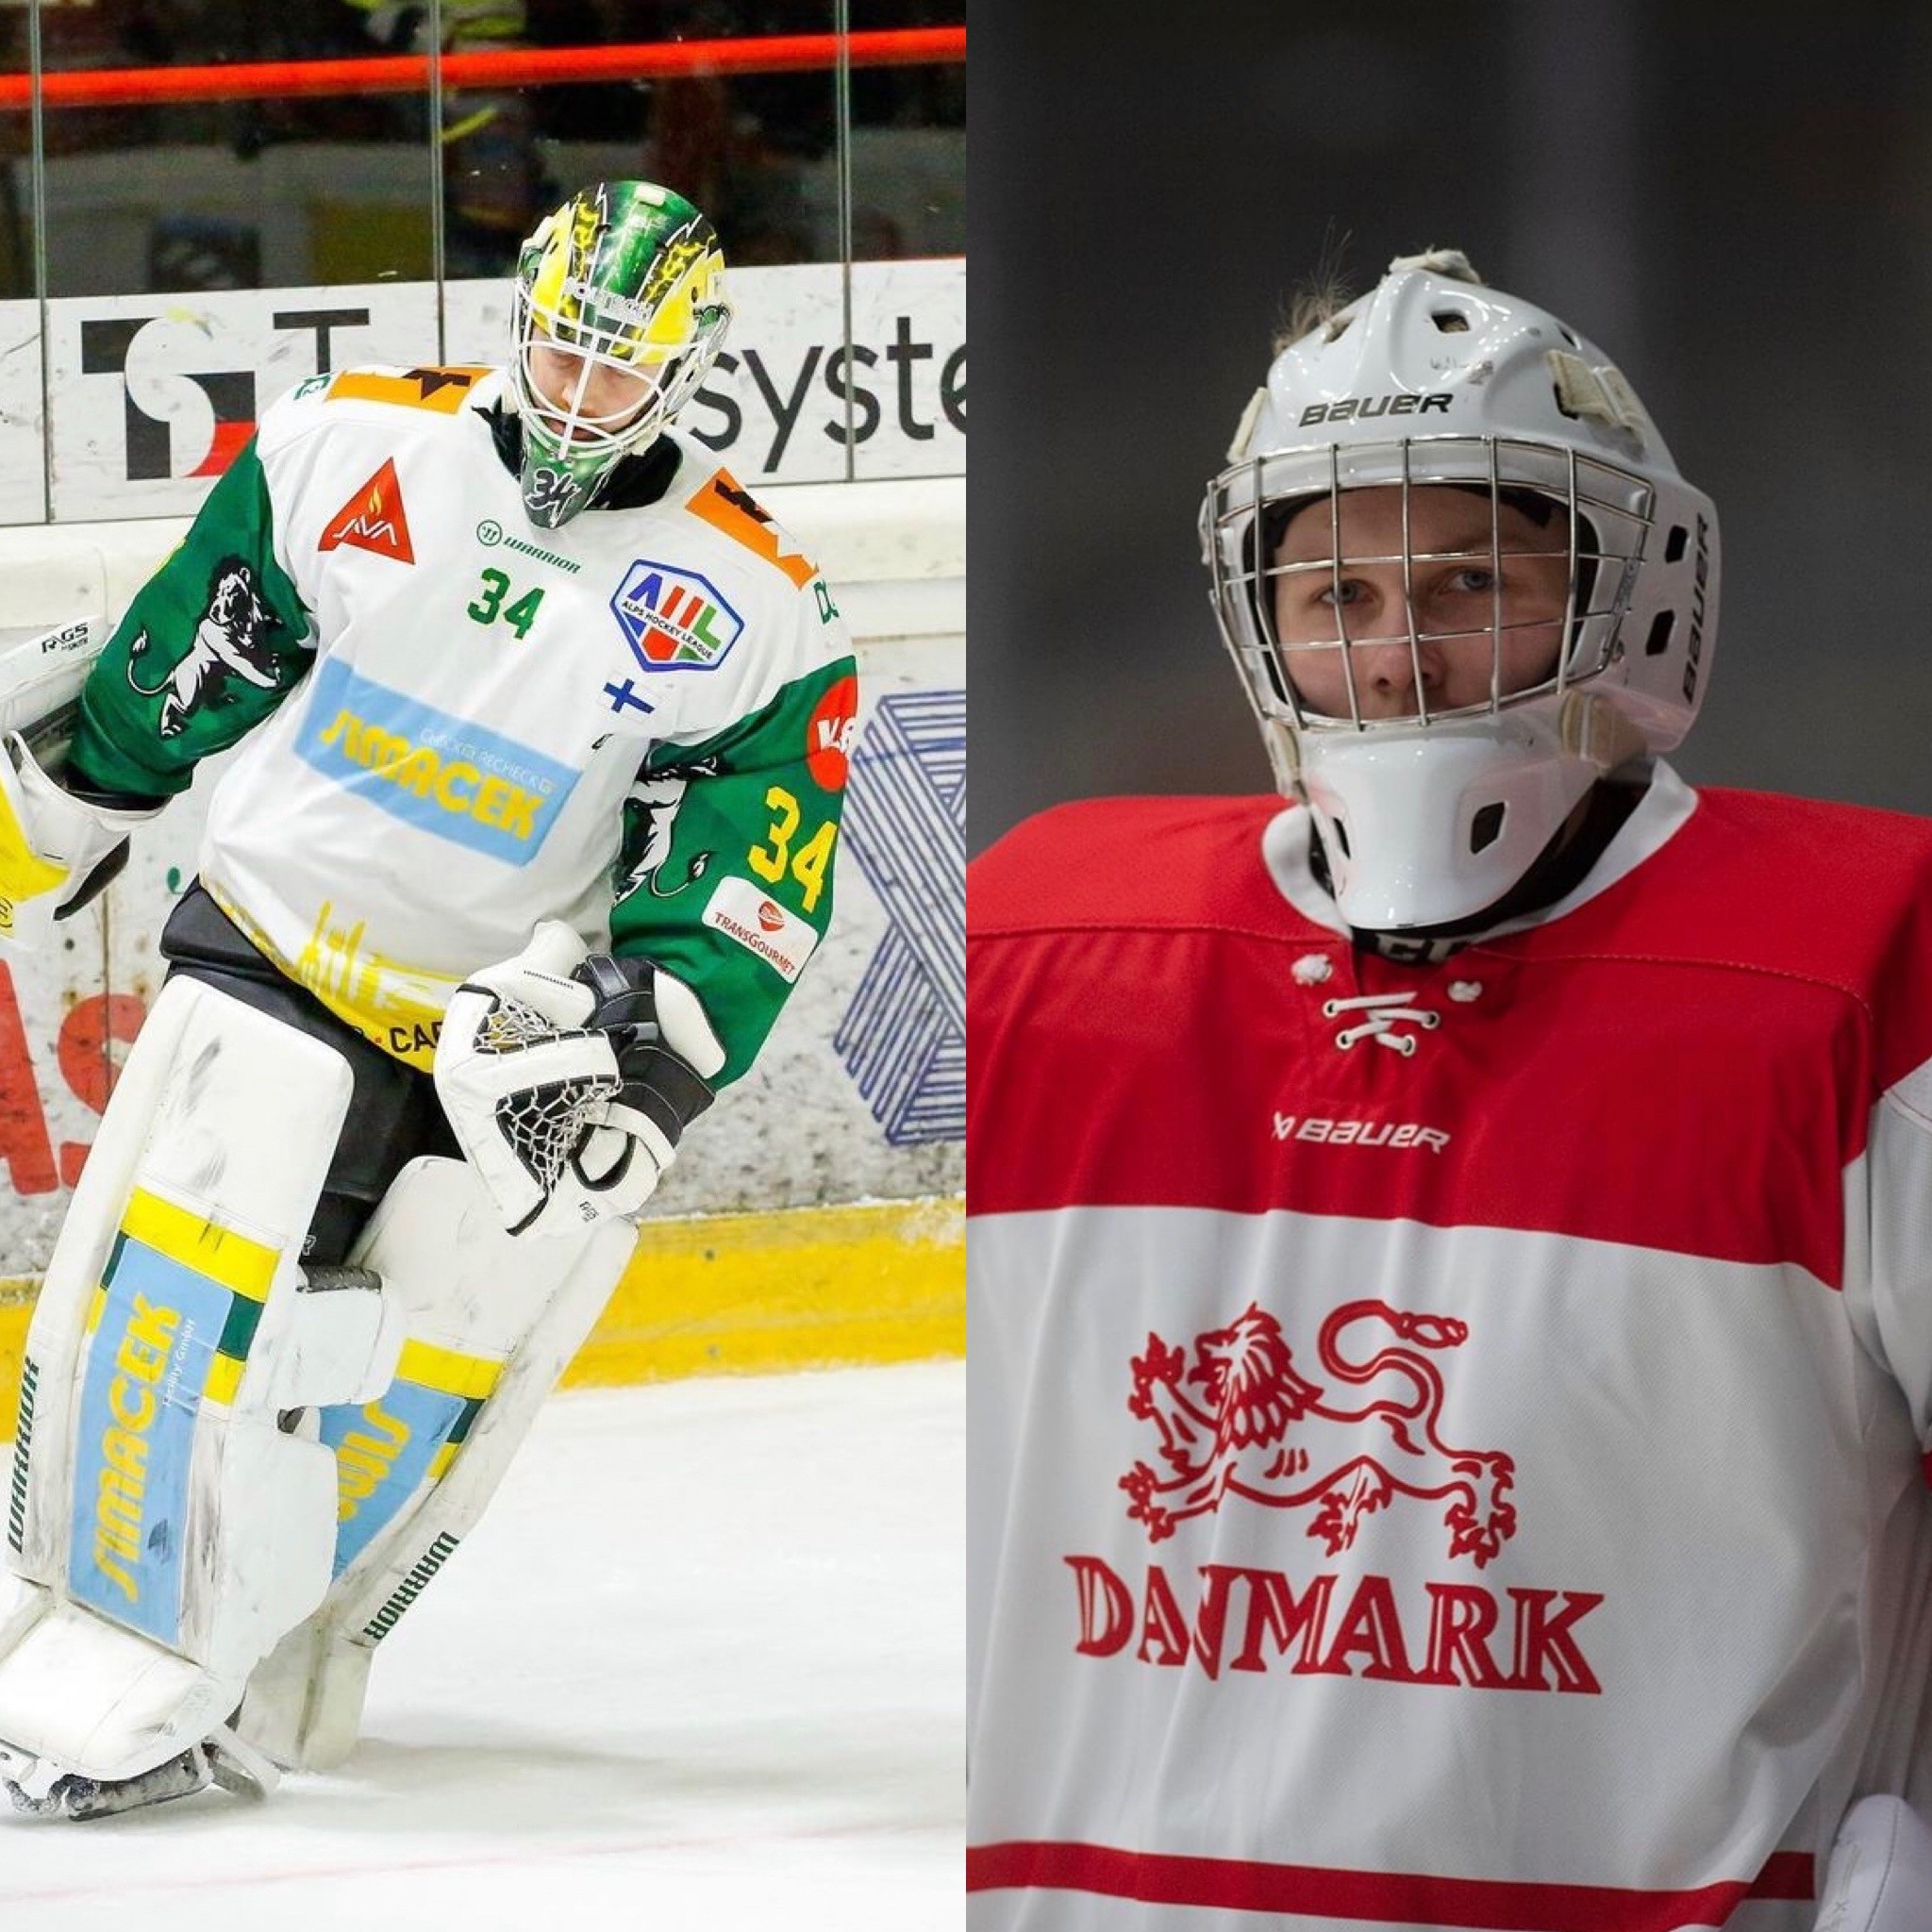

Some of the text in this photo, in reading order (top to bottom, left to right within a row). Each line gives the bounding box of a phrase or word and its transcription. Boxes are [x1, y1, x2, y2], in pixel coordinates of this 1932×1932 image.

[525, 467, 583, 529] 34
[502, 535, 582, 574] WARRIOR
[467, 567, 545, 640] 34
[621, 600, 713, 659] ALPS HOCKEY LEAGUE
[748, 786, 838, 913] 34
[715, 911, 795, 975] TRANSGOURMET
[94, 1291, 182, 1603] SIMACEK
[362, 1531, 460, 1640] WARRIOR
[1063, 1555, 1606, 1695] DANMARK
